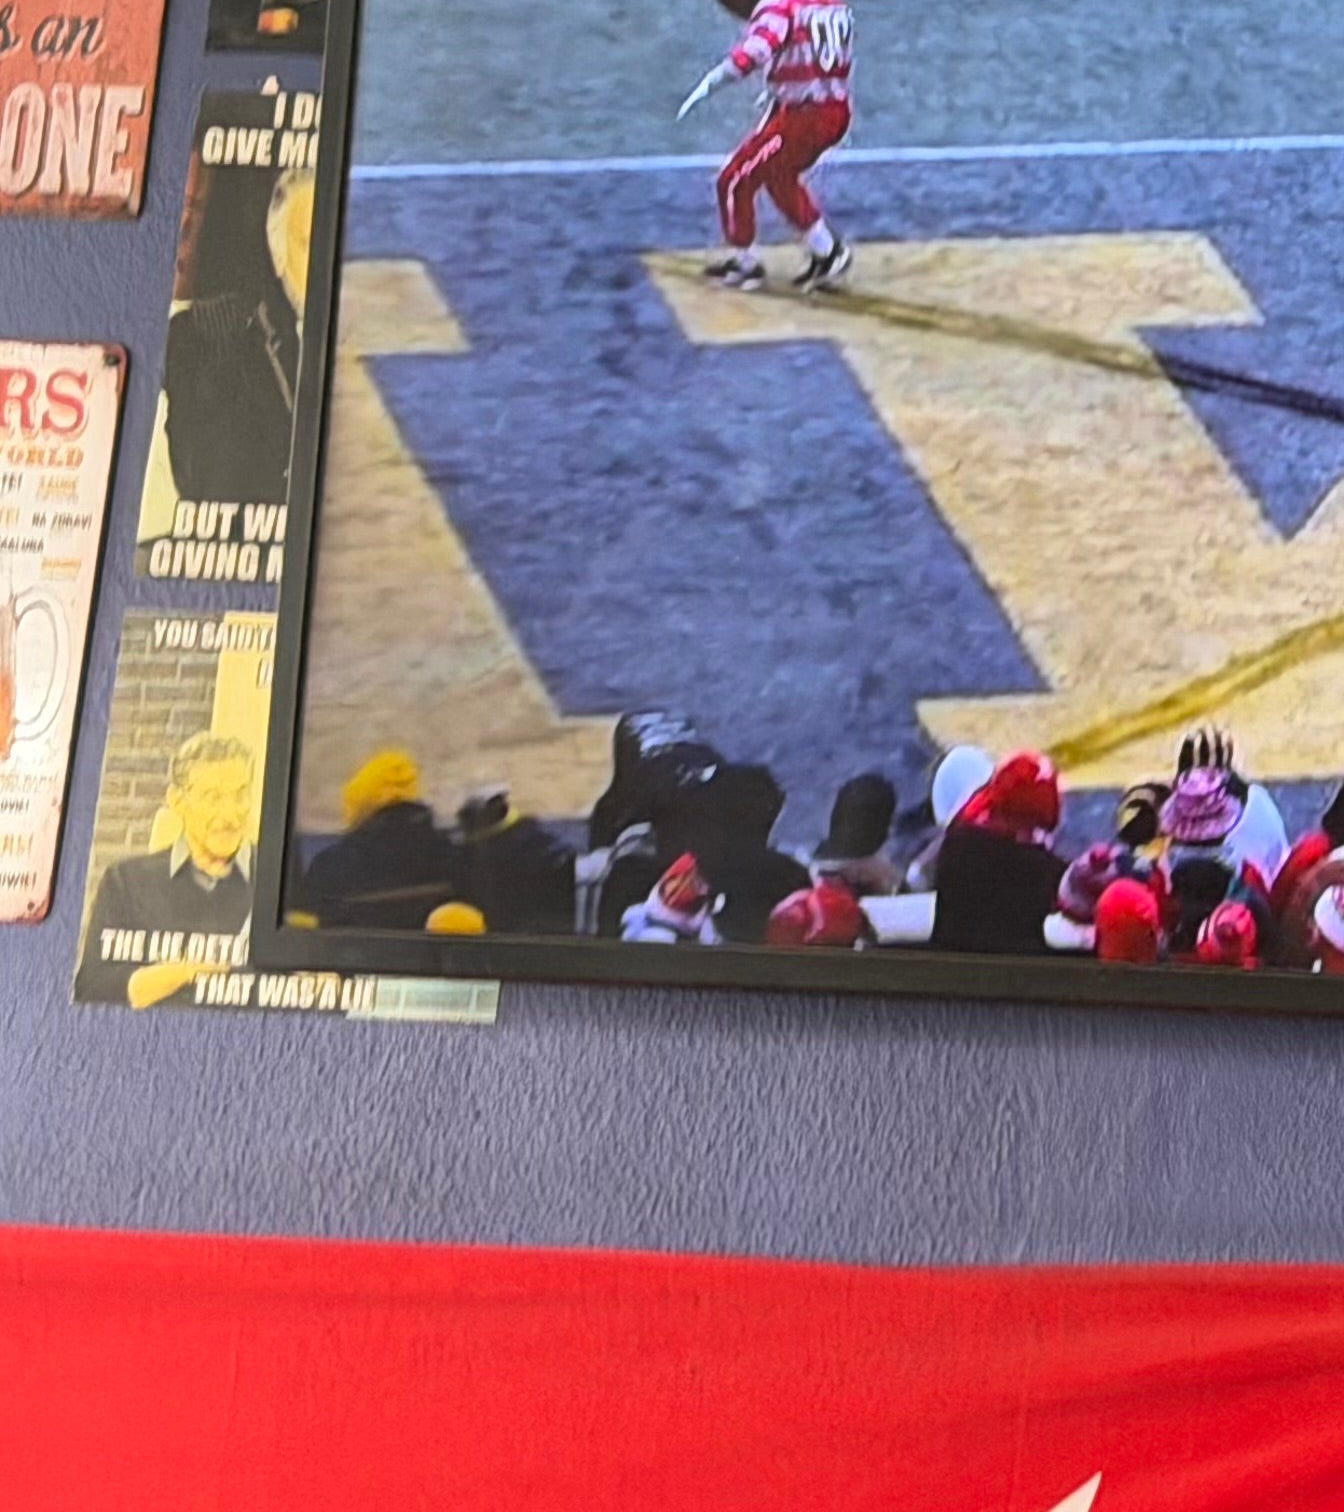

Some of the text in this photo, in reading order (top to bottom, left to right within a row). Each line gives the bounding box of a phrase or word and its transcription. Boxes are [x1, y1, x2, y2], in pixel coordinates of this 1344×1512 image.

[31, 15, 105, 59] an
[273, 91, 288, 130] I
[202, 126, 274, 167] GIVE
[0, 446, 83, 469] ORLD
[173, 500, 240, 541] BUT
[149, 539, 260, 582] GIVING
[154, 619, 198, 649] YOU
[101, 928, 145, 962] THE
[149, 931, 184, 964] LIE
[193, 972, 254, 1006] THAT
[257, 973, 317, 1009] WAS
[318, 974, 337, 1010] A
